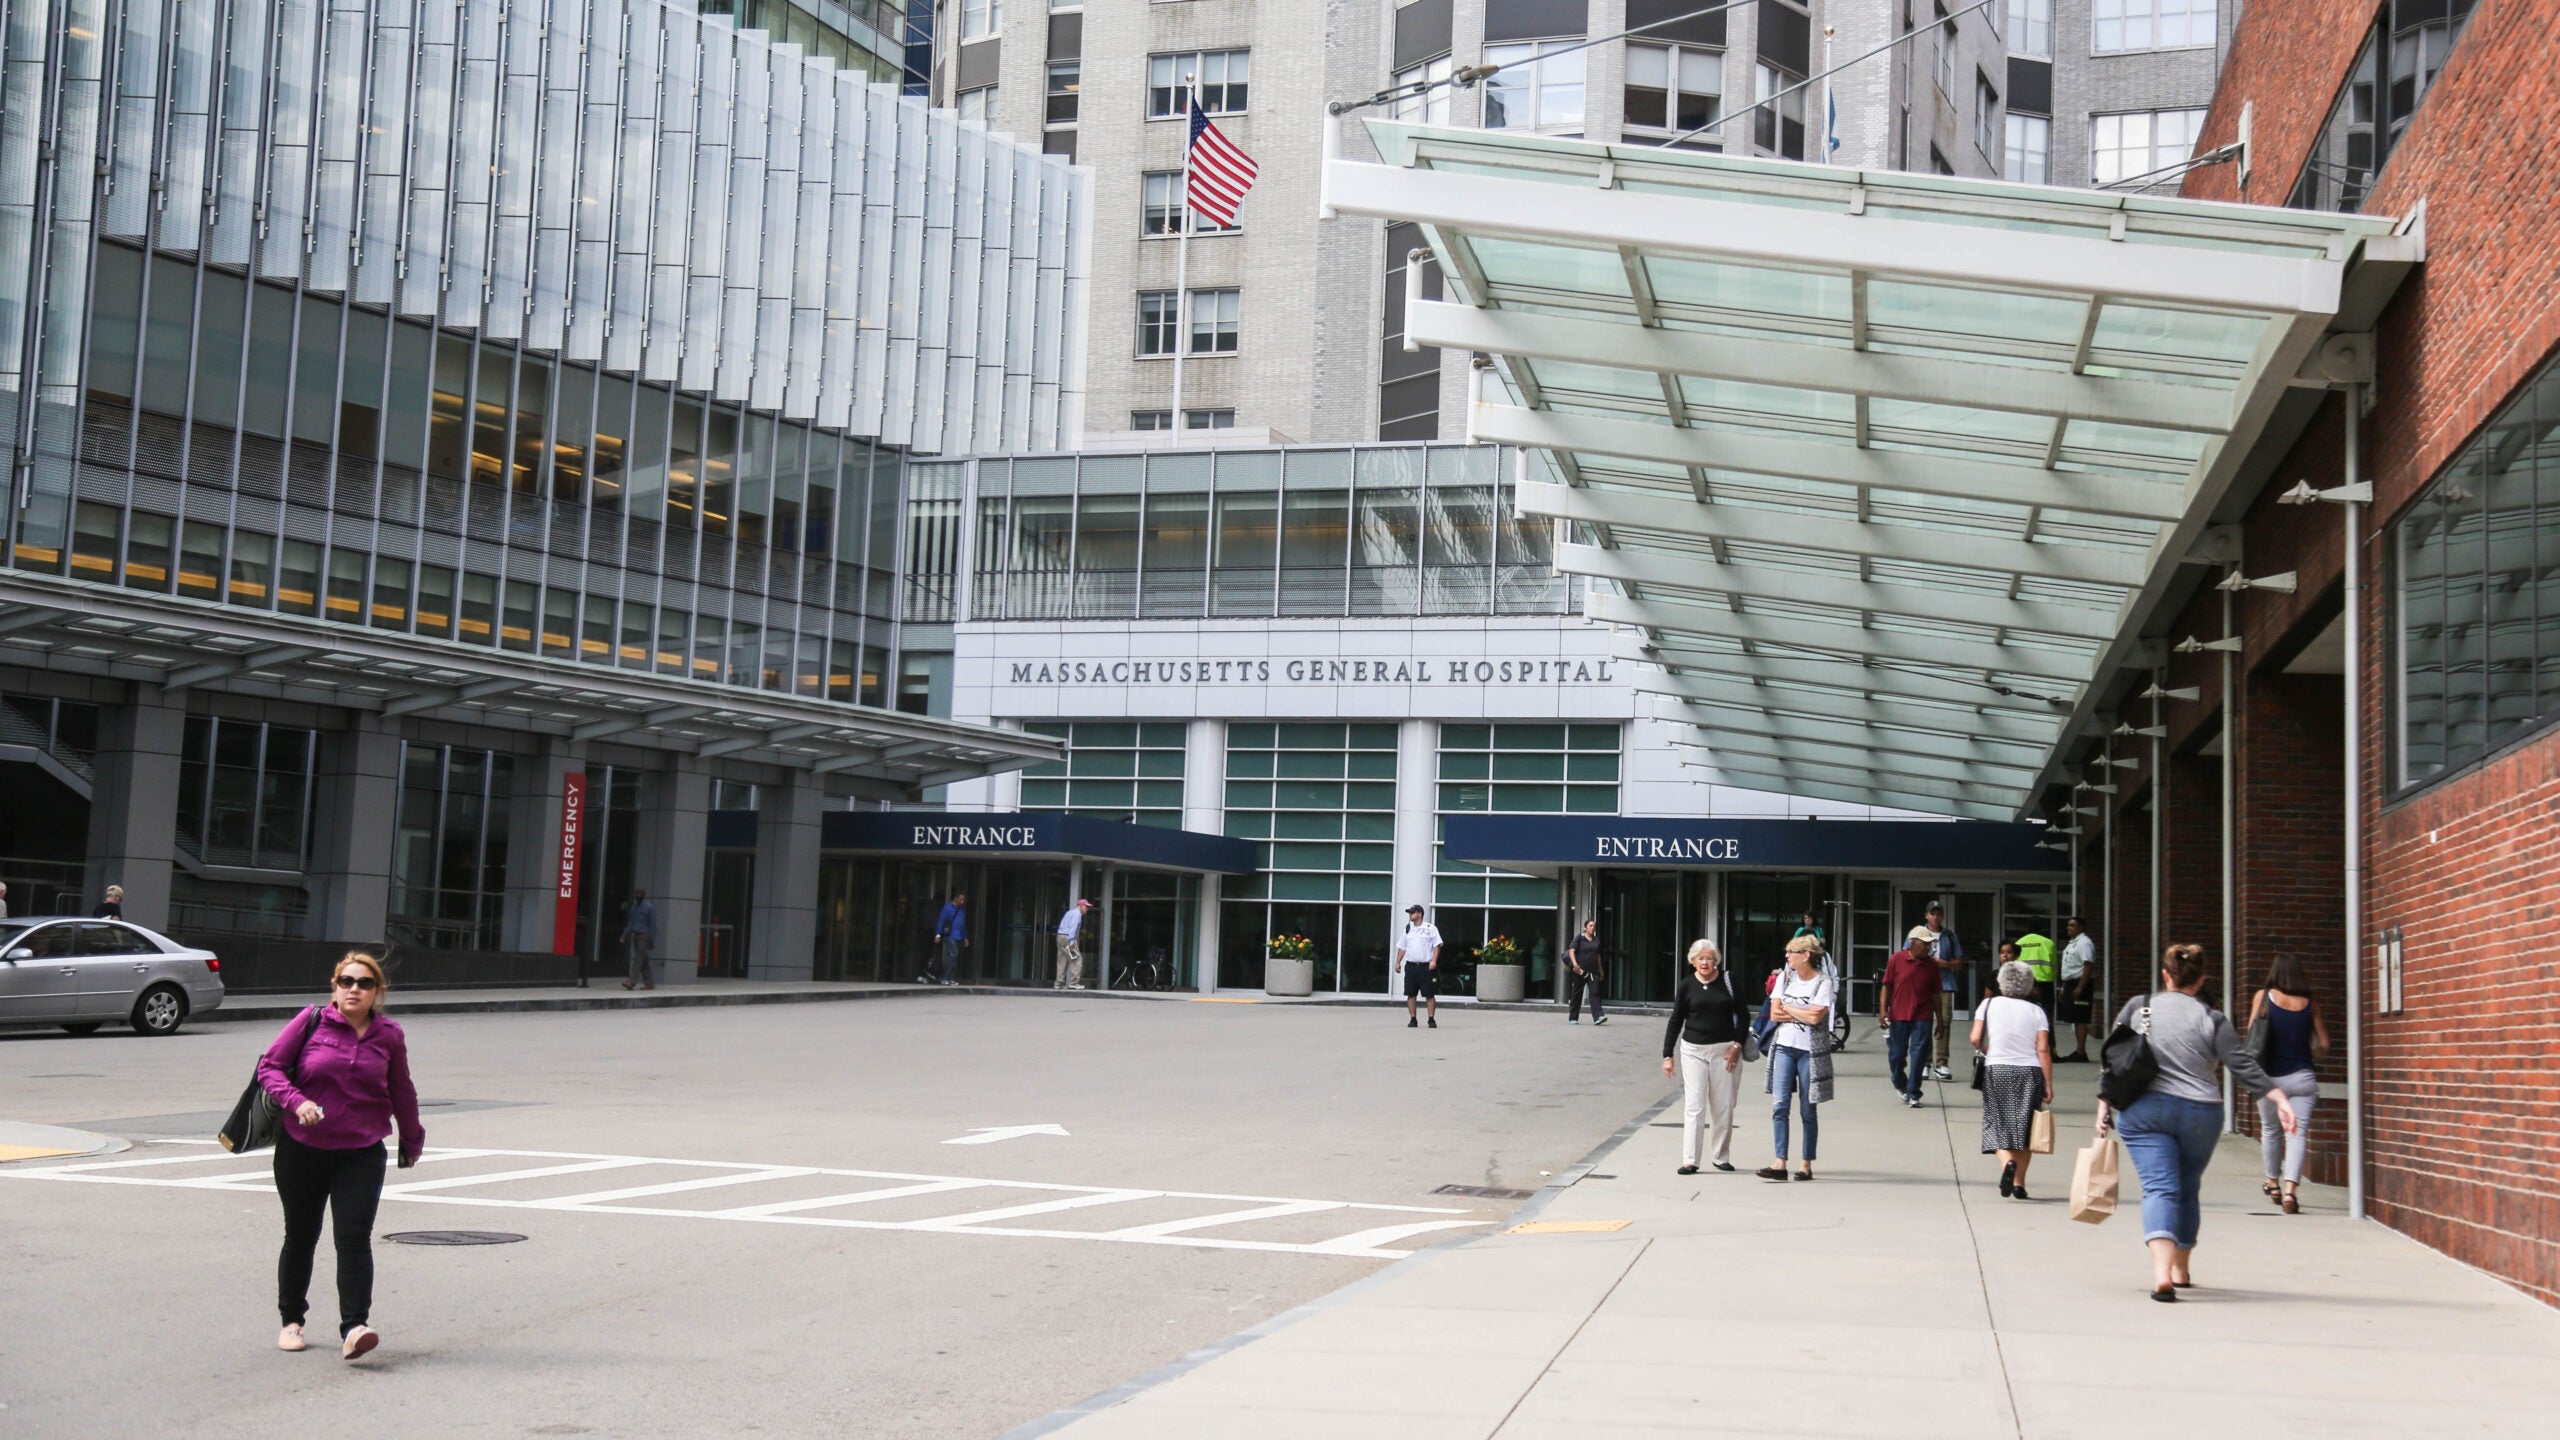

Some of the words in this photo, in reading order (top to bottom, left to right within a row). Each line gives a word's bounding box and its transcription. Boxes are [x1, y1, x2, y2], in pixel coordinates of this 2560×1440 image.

[1010, 660, 1270, 682] MASSACHUSETTS
[1286, 660, 1432, 682] GENERAL
[1448, 660, 1613, 682] HOSPITAL
[560, 783, 579, 898] EMERGENCY
[912, 826, 1036, 846] ENTRANCE
[1596, 837, 1740, 859] ENTRANCE
